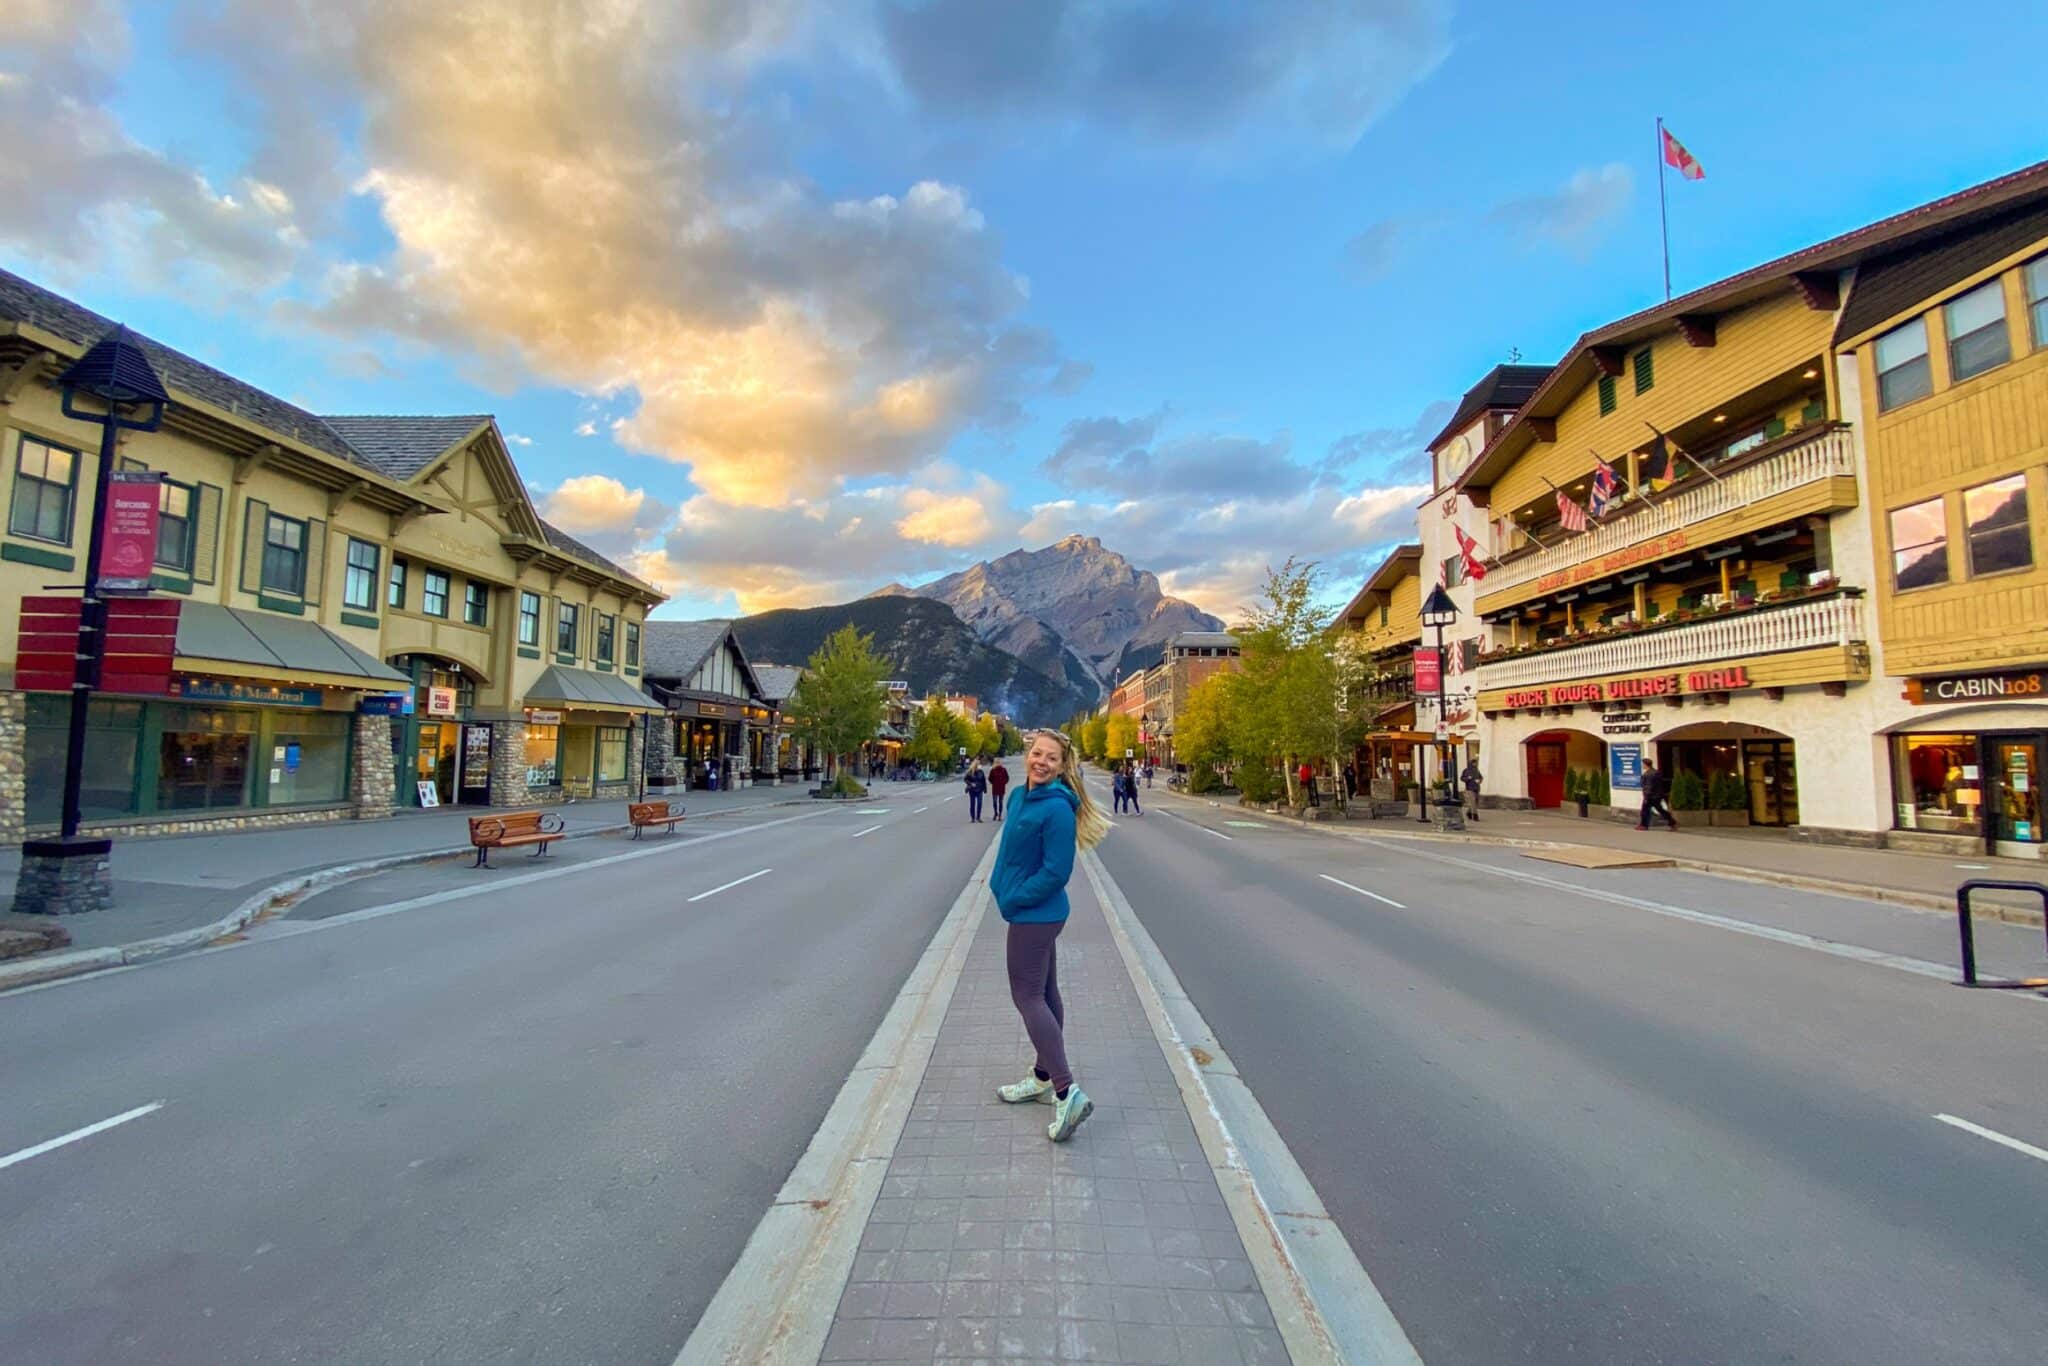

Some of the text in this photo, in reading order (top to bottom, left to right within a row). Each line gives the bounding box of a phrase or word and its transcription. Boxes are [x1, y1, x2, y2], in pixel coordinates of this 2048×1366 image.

[190, 681, 304, 702] Bank of Montreal
[1504, 666, 1751, 708] CLOCK TOWER VILLAGE MALL
